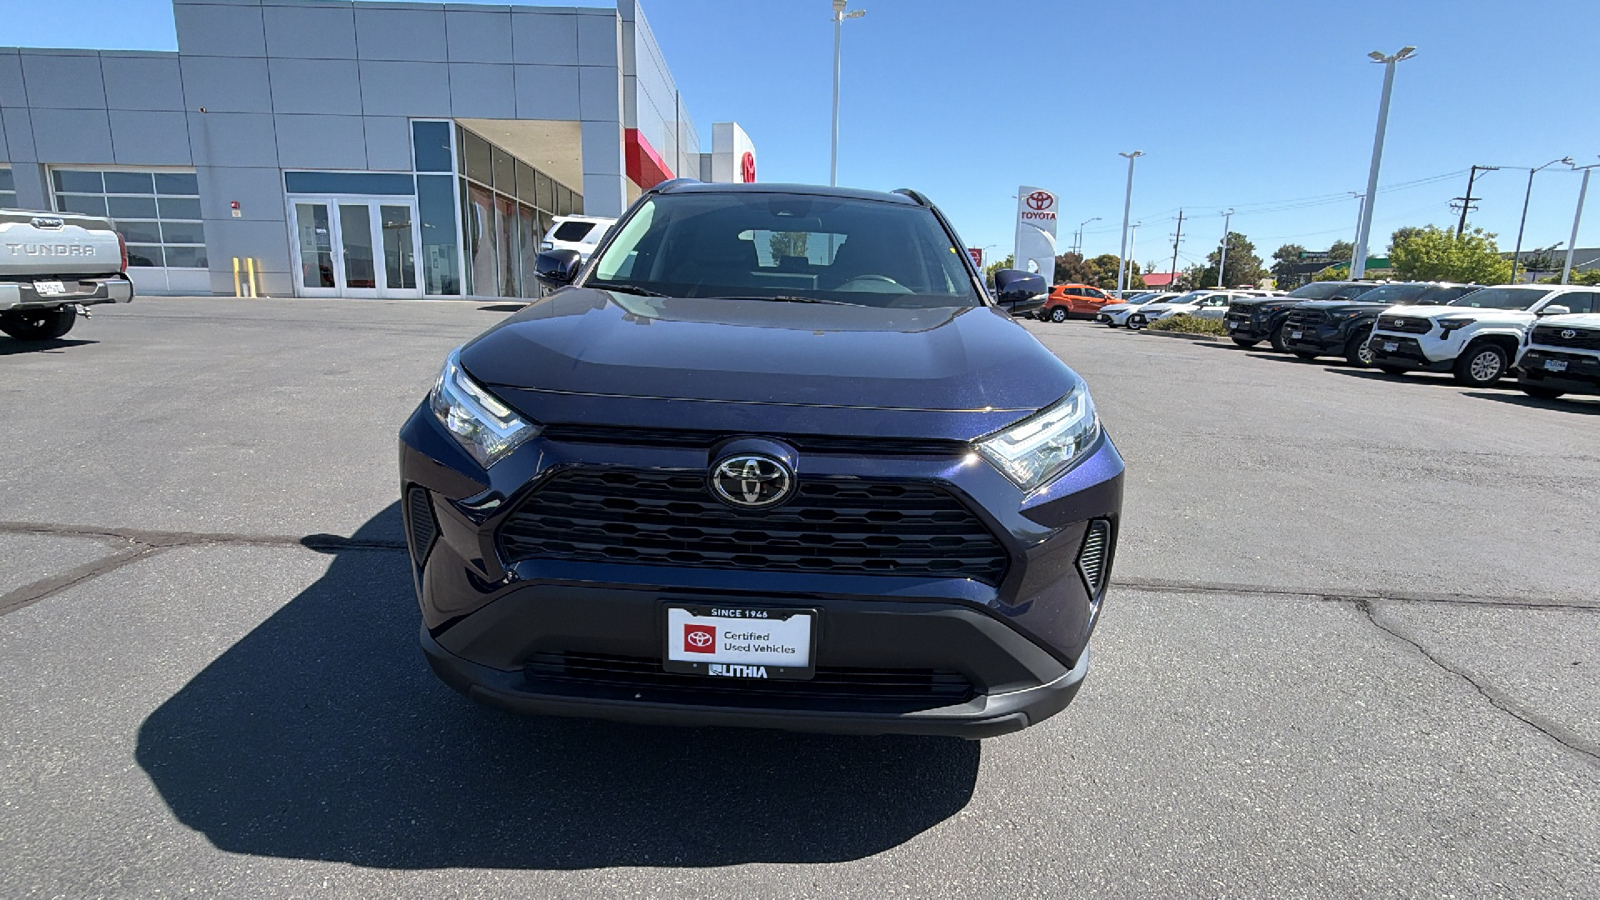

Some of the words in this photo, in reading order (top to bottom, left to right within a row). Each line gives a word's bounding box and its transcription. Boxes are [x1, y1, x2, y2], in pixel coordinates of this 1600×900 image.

[1021, 211, 1057, 220] TOYOTA
[5, 243, 96, 256] TUNDRA
[711, 608, 742, 618] SINCE
[744, 609, 768, 618] 1946
[724, 631, 770, 642] Certified
[724, 643, 751, 652] Used
[753, 644, 796, 654] Vehicles
[722, 664, 768, 679] LITHIA
